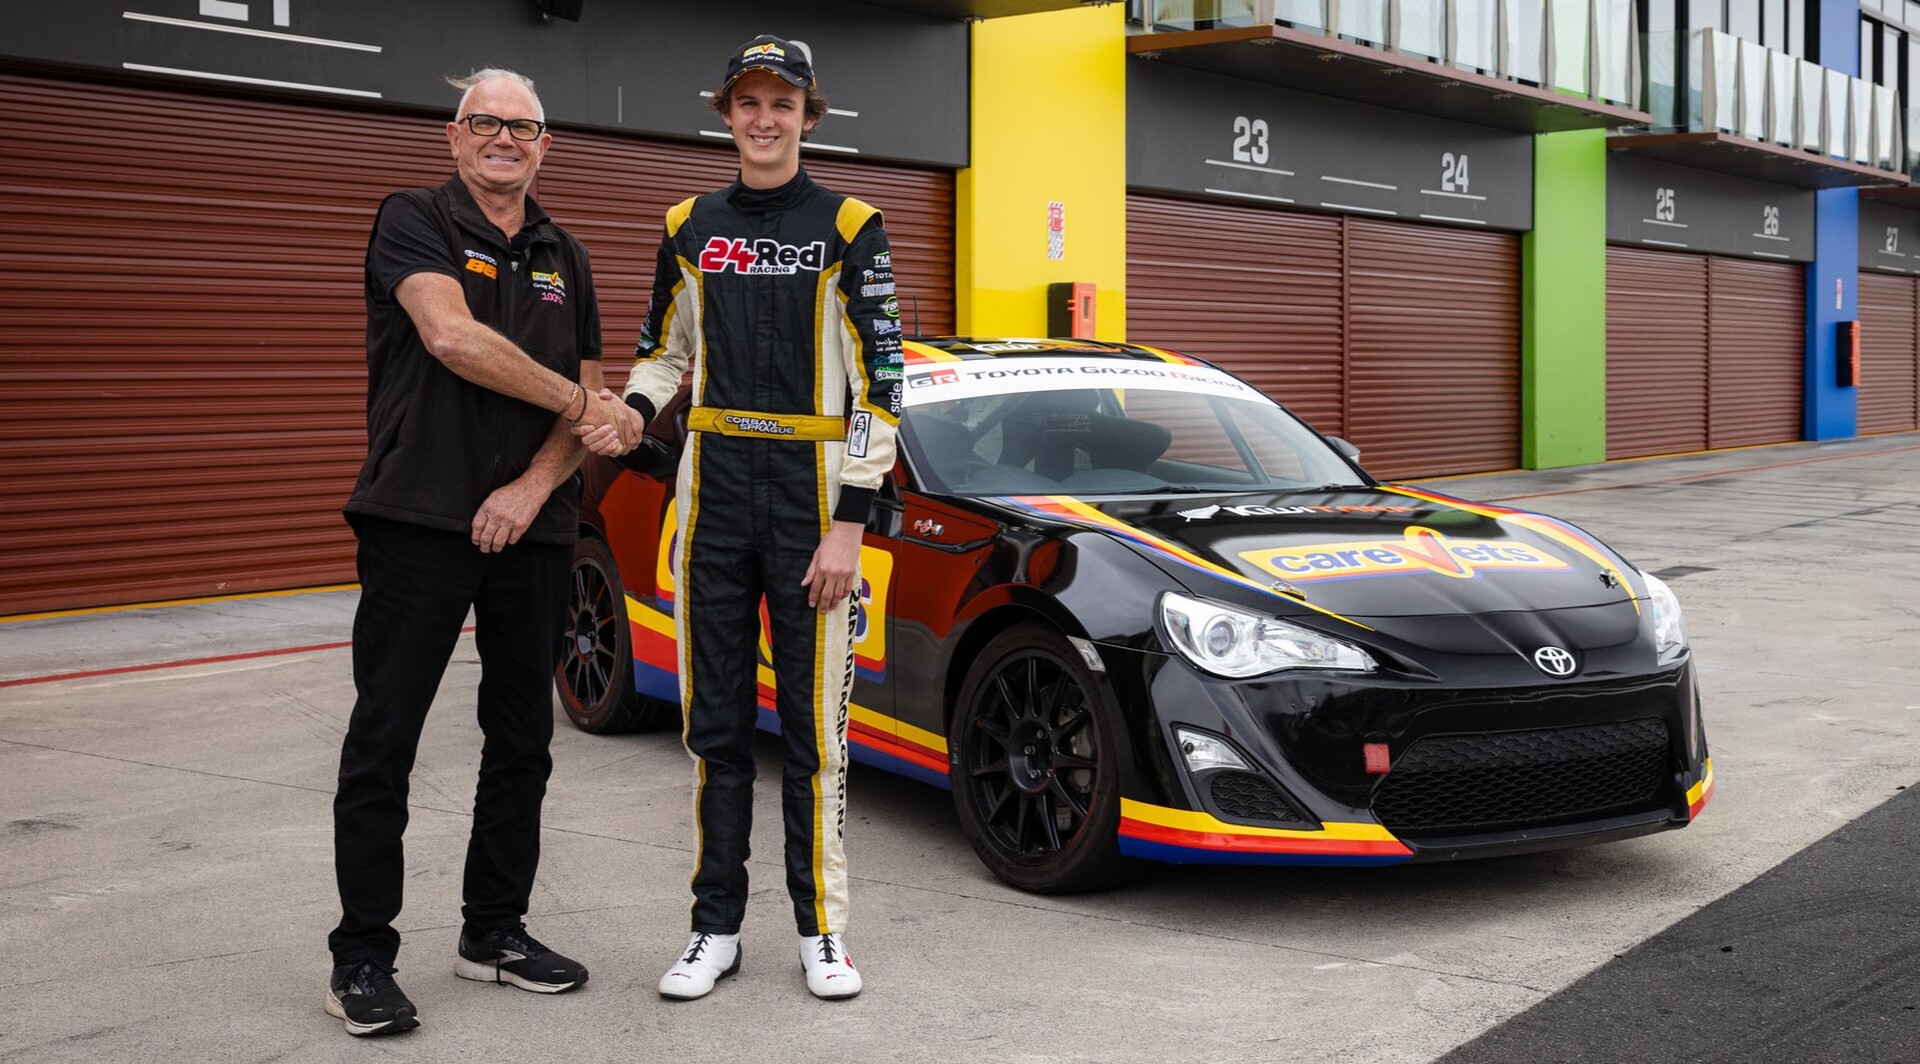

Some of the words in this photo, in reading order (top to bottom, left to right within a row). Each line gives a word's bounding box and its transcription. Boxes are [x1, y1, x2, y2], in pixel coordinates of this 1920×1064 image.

[1233, 116, 1269, 164] 23
[1441, 152, 1469, 193] 24
[1656, 187, 1675, 221] 25
[1763, 205, 1779, 235] 26
[1886, 226, 1899, 252] 27
[465, 258, 498, 280] 86
[749, 266, 790, 274] RACING
[906, 369, 960, 389] GR
[967, 367, 1074, 381] TOYOTA
[1170, 372, 1245, 391] Racing
[725, 415, 778, 428] CORBAN
[739, 423, 795, 434] SPRAGUE
